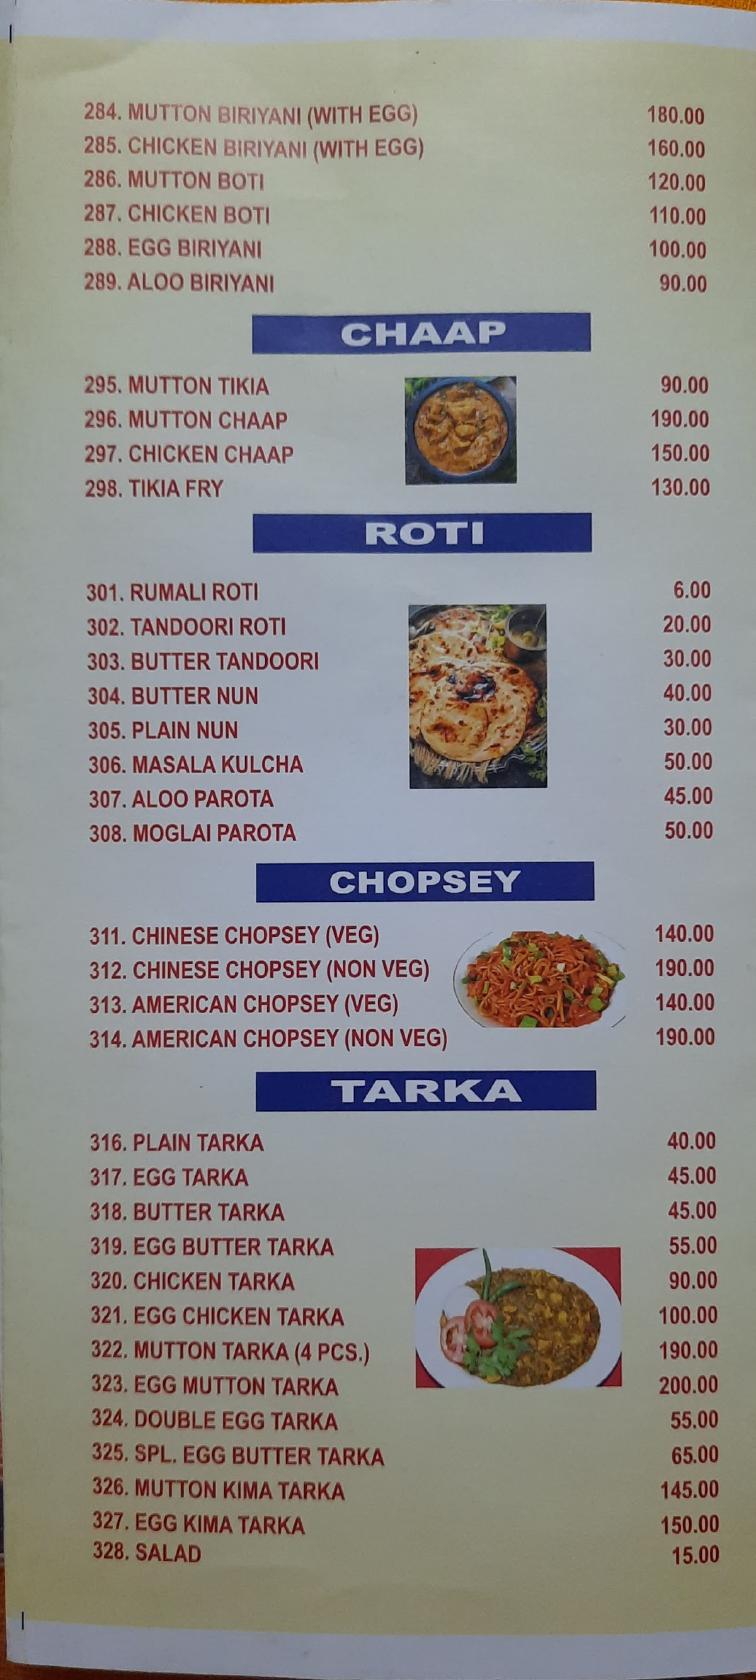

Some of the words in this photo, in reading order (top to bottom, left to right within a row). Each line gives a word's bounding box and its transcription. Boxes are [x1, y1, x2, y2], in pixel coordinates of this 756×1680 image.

[83, 102, 122, 120] 284.
[128, 103, 212, 122] MUTTON
[218, 107, 302, 125] BIRIYANI
[307, 105, 363, 130] (WITH
[368, 104, 418, 126] EGG)
[647, 105, 705, 125] 180.00
[84, 136, 122, 153] 285.
[127, 136, 217, 156] CHICKEN
[223, 139, 307, 158] BIRIYANI
[312, 140, 368, 163] (WITH
[375, 138, 424, 160] EGG)
[647, 139, 706, 158] 160.00
[83, 170, 122, 187] 286.
[128, 170, 212, 189] MUTTON
[217, 172, 264, 190] BOTI
[648, 172, 706, 192] 120.00
[83, 204, 122, 222] 287.
[127, 204, 217, 223] CHICKEN
[223, 206, 270, 224] BOTI
[649, 206, 707, 225] 110.00
[83, 238, 122, 256] 288.
[128, 238, 172, 257] EGG
[177, 239, 262, 259] BIRIYANI
[649, 240, 707, 259] 100.00
[84, 272, 122, 290] 289.
[126, 272, 185, 291] ALOO
[190, 272, 275, 293] BIRIYANI
[659, 274, 708, 293] 90.00
[341, 322, 506, 346] CHAAP
[83, 375, 123, 394] 295.
[128, 375, 212, 395] MUTTON
[217, 377, 270, 395] TIKIA
[660, 375, 709, 394] 90.00
[84, 410, 123, 428] 296.
[128, 410, 212, 429] MUTTON
[218, 411, 288, 430] CHAAP
[651, 409, 710, 428] 190.00
[84, 444, 123, 463] 297.
[128, 444, 219, 463] CHICKEN
[224, 445, 294, 464] CHAAP
[651, 443, 710, 462] 150.00
[84, 479, 123, 498] 298.
[127, 479, 181, 497] TIKIA
[185, 479, 225, 497] FRY
[651, 478, 711, 496] 130.00
[365, 523, 484, 544] ROTI
[86, 584, 125, 602] 301.
[130, 583, 206, 602] RUMALI
[212, 582, 259, 601] ROTI
[673, 581, 711, 599] 6.00
[86, 618, 125, 636] 302.
[129, 617, 234, 636] TANDOORI
[239, 617, 286, 636] ROTI
[662, 615, 712, 633] 20.00
[87, 652, 126, 671] 303.
[131, 652, 212, 670] BUTTER
[215, 652, 319, 670] TANDOORI
[663, 649, 712, 667] 30.00
[87, 687, 126, 705] 304.
[131, 687, 212, 705] BUTTER
[216, 686, 259, 704] NUN
[663, 683, 712, 702] 40.00
[87, 721, 127, 739] 305.
[131, 721, 191, 739] PLAIN
[196, 721, 239, 739] NUN
[663, 718, 713, 736] 30.00
[88, 756, 127, 774] 306.
[132, 755, 217, 774] MASALA
[221, 755, 304, 773] KULCHA
[664, 752, 713, 770] 50.00
[88, 790, 127, 808] 307.
[131, 789, 190, 808] ALOO
[194, 789, 275, 808] PAROTA
[663, 786, 714, 805] 45.00
[88, 824, 127, 842] 308.
[132, 824, 212, 842] MOGLAI
[217, 824, 297, 842] PAROTA
[664, 821, 714, 839] 50.00
[330, 871, 521, 893] CHOPSEY
[89, 927, 127, 945] 311.
[131, 926, 219, 945] CHINESE
[224, 926, 321, 944] CHOPSEY
[325, 925, 380, 949] (VEG)
[654, 924, 715, 942] 140.00
[89, 961, 127, 979] 312.
[132, 961, 220, 979] CHINESE
[225, 960, 322, 979] CHOPSEY
[326, 960, 376, 983] (NON
[381, 959, 430, 982] VEG)
[655, 959, 715, 976] 190.00
[89, 996, 127, 1014] 313.
[131, 995, 237, 1013] AMERICAN
[243, 994, 340, 1013] CHOPSEY
[344, 993, 399, 1017] (VEG)
[655, 993, 715, 1011] 140.00
[89, 1030, 127, 1048] 314.
[130, 1029, 237, 1048] AMERICAN
[242, 1029, 340, 1048] CHOPSEY
[344, 1028, 394, 1052] (NON
[399, 1028, 448, 1052] VEG)
[655, 1027, 716, 1046] 190.00
[331, 1080, 522, 1102] TARKA
[90, 1133, 127, 1151] 316.
[133, 1133, 191, 1152] PLAIN
[196, 1133, 265, 1152] TARKA
[666, 1131, 717, 1150] 40.00
[90, 1168, 127, 1186] 317.
[133, 1168, 176, 1187] EGG
[181, 1168, 250, 1187] TARKA
[667, 1166, 717, 1185] 45.00
[89, 1202, 128, 1221] 318.
[133, 1202, 213, 1222] BUTTER
[217, 1202, 286, 1221] TARKA
[667, 1201, 717, 1220] 45.00
[90, 1237, 128, 1256] 319.
[133, 1237, 177, 1256] EGG
[182, 1237, 262, 1256] BUTTER
[266, 1238, 335, 1256] TARKA
[668, 1236, 718, 1255] 55.00
[90, 1271, 128, 1290] 320.
[133, 1272, 222, 1291] CHICKEN
[227, 1272, 296, 1291] TARKA
[668, 1270, 718, 1290] 90.00
[90, 1305, 128, 1324] 321.
[133, 1306, 177, 1325] EGG
[182, 1306, 271, 1326] CHICKEN
[276, 1307, 345, 1327] TARKA
[658, 1305, 719, 1325] 100.00
[91, 1340, 128, 1359] 322.
[133, 1340, 217, 1360] MUTTON
[221, 1342, 290, 1361] TARKA
[294, 1342, 313, 1366] (4
[317, 1342, 370, 1367] PCS.)
[659, 1340, 719, 1360] 190.00
[91, 1374, 128, 1393] 323.
[133, 1375, 177, 1394] EGG
[183, 1376, 266, 1396] MUTTON
[270, 1377, 340, 1396] TARKA
[658, 1375, 719, 1395] 200.00
[91, 1408, 129, 1427] 324.
[134, 1409, 217, 1431] DOUBLE
[222, 1411, 265, 1430] EGG
[270, 1411, 339, 1432] TARKA
[670, 1410, 719, 1430] 55.00
[91, 1442, 129, 1462] 325.
[134, 1443, 177, 1464] SPL.
[183, 1445, 226, 1465] EGG
[231, 1446, 312, 1466] BUTTER
[316, 1447, 386, 1467] TARKA
[671, 1445, 720, 1464] 65.00
[92, 1476, 129, 1496] 326.
[134, 1478, 217, 1499] MUTTON
[223, 1481, 274, 1500] KIMA
[276, 1481, 346, 1501] TARKA
[660, 1480, 720, 1500] 145.00
[92, 1510, 130, 1531] 327.
[135, 1512, 178, 1533] EGG
[183, 1514, 234, 1534] KIMA
[237, 1515, 306, 1536] TARKA
[660, 1514, 720, 1535] 150.00
[92, 1541, 130, 1560] 328.
[135, 1543, 202, 1563] SALAD
[671, 1544, 720, 1565] 15.00
